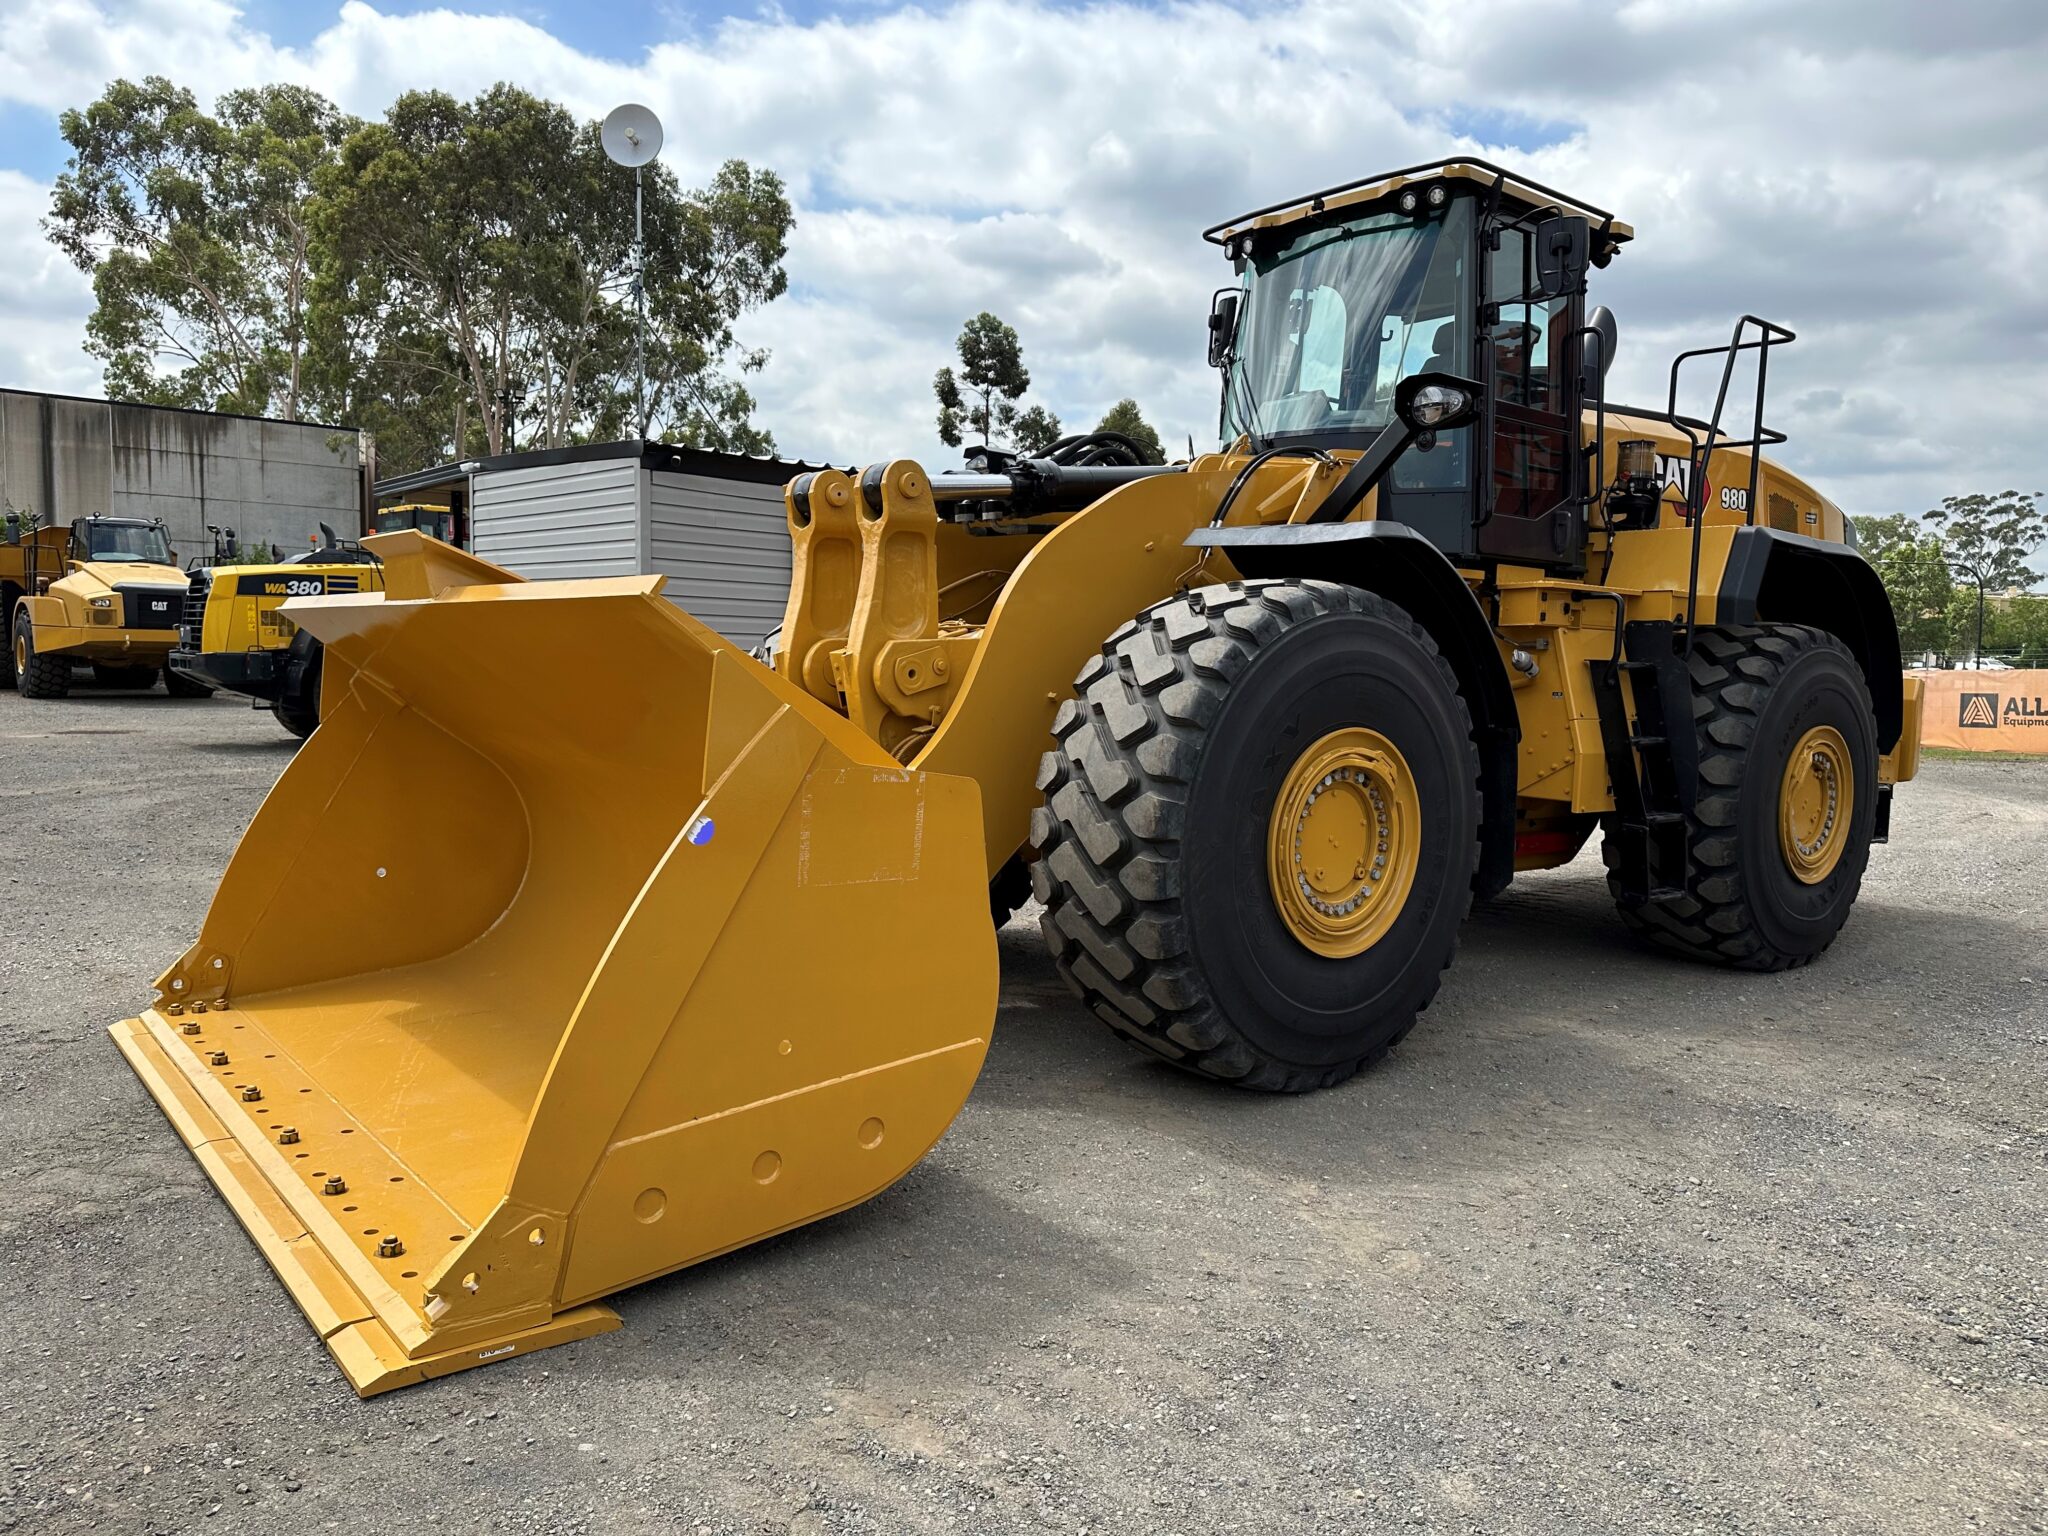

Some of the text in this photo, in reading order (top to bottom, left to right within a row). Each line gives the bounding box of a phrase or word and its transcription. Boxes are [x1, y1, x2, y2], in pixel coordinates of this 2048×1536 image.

[1721, 486, 1747, 511] 980
[265, 580, 322, 595] WA380
[151, 600, 169, 611] CAT
